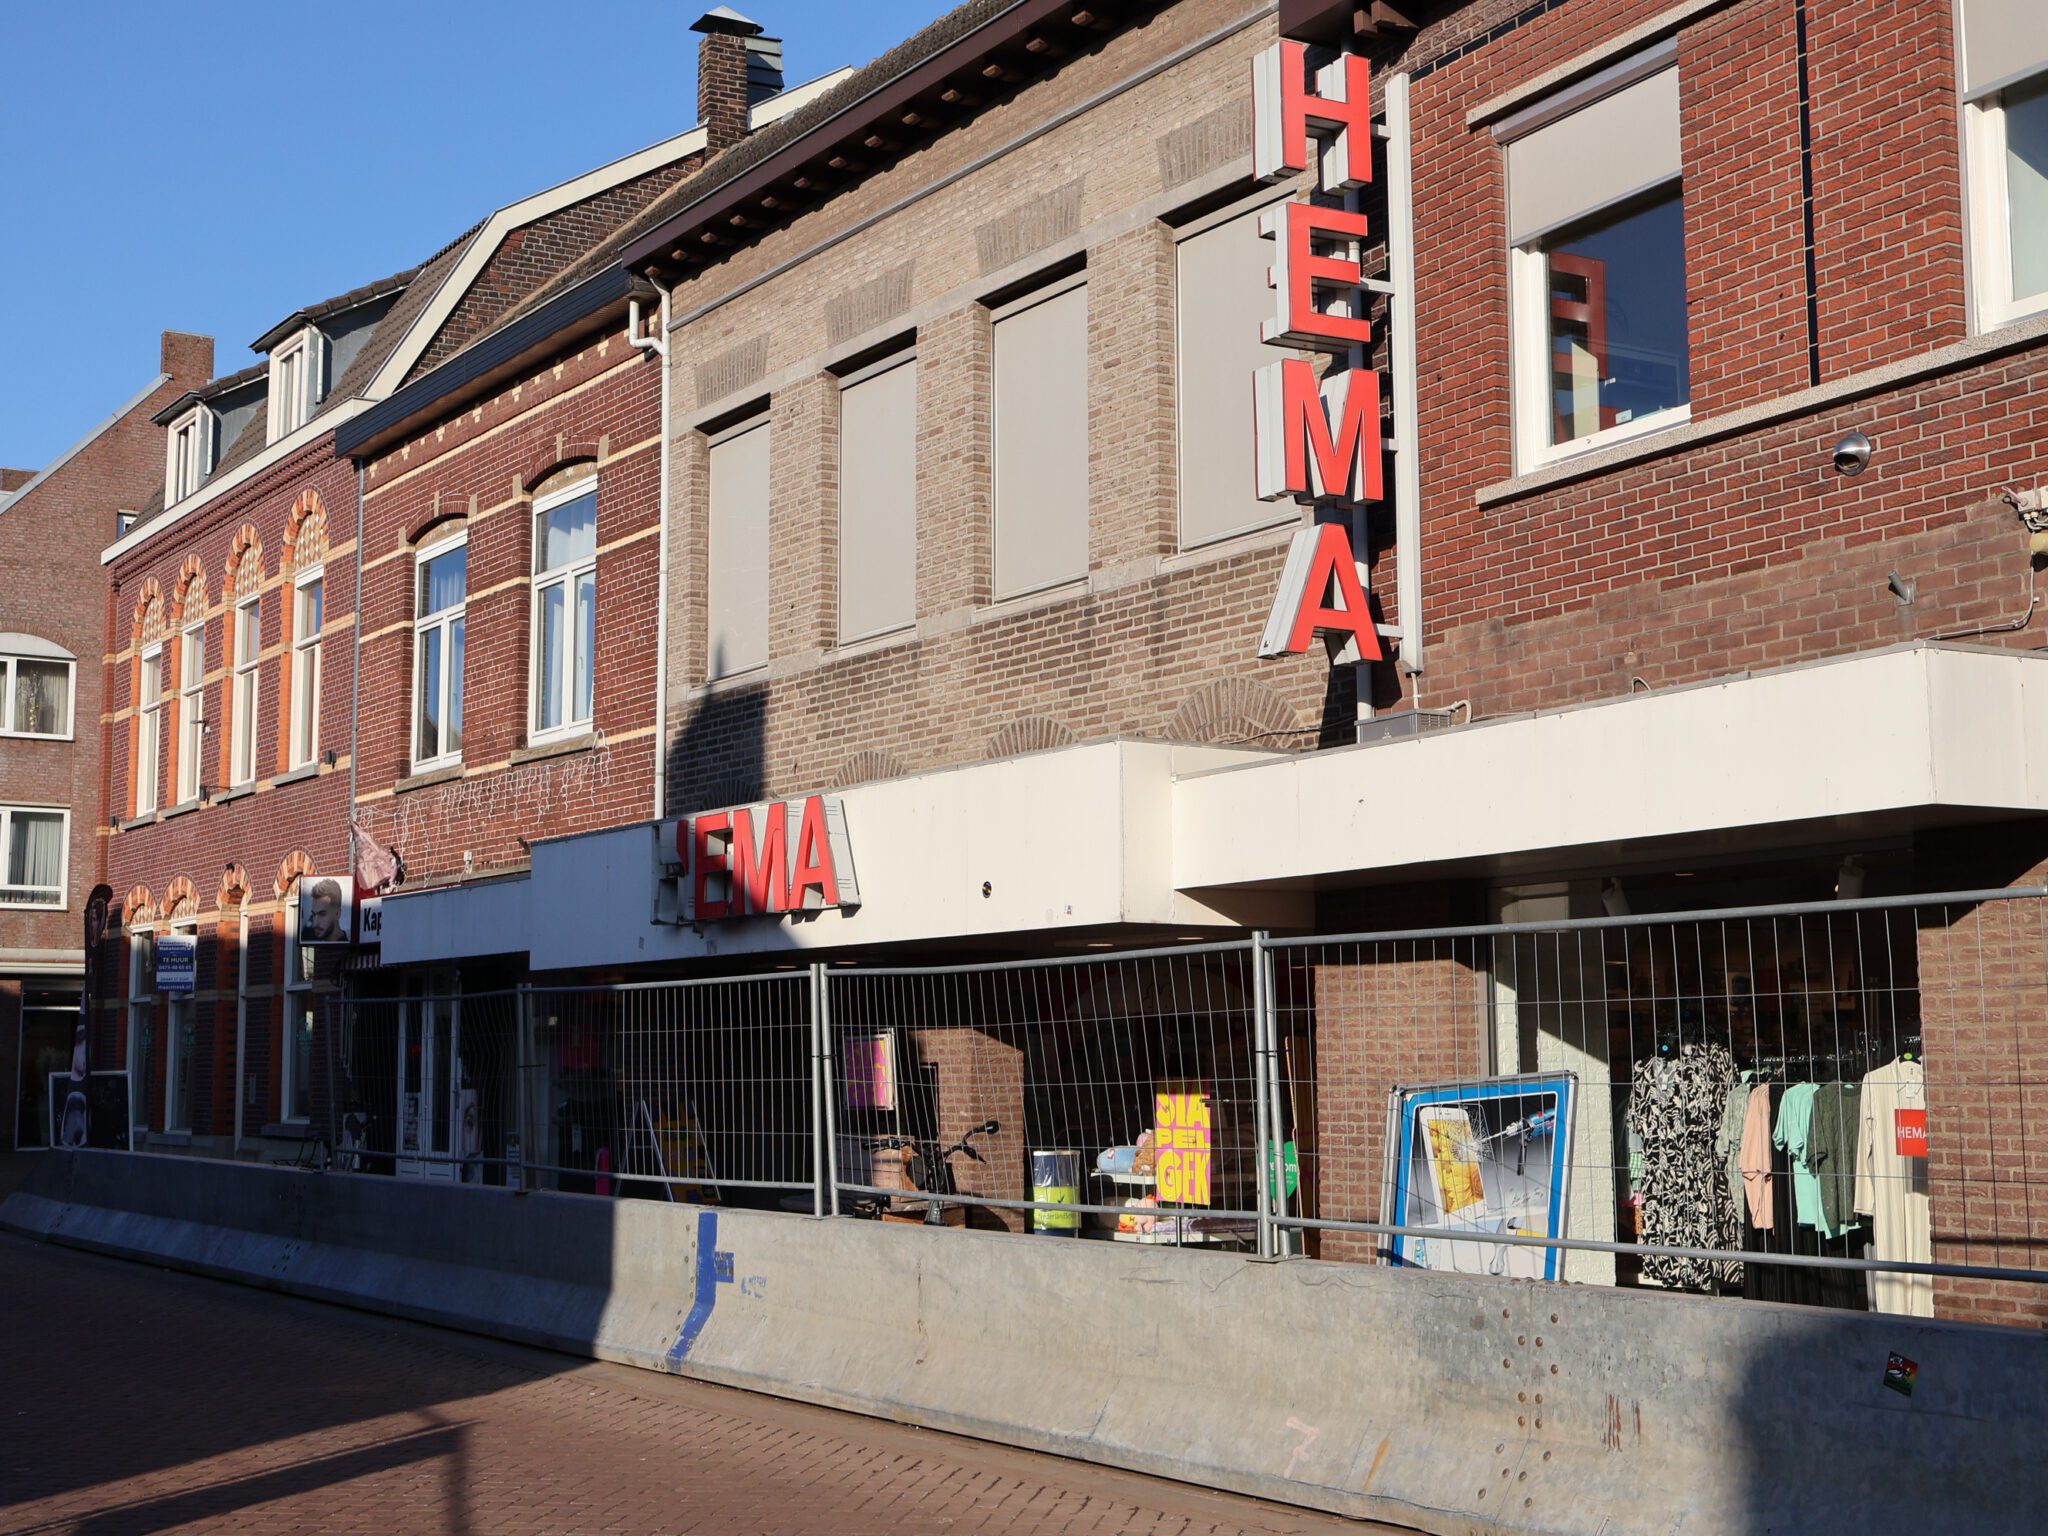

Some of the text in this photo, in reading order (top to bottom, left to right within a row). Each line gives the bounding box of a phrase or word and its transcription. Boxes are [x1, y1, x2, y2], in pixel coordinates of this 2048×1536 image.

[1276, 40, 1384, 663] HEMA
[676, 795, 841, 920] EMA
[1155, 1128, 1211, 1149] PEL
[1157, 1150, 1211, 1205] GEK
